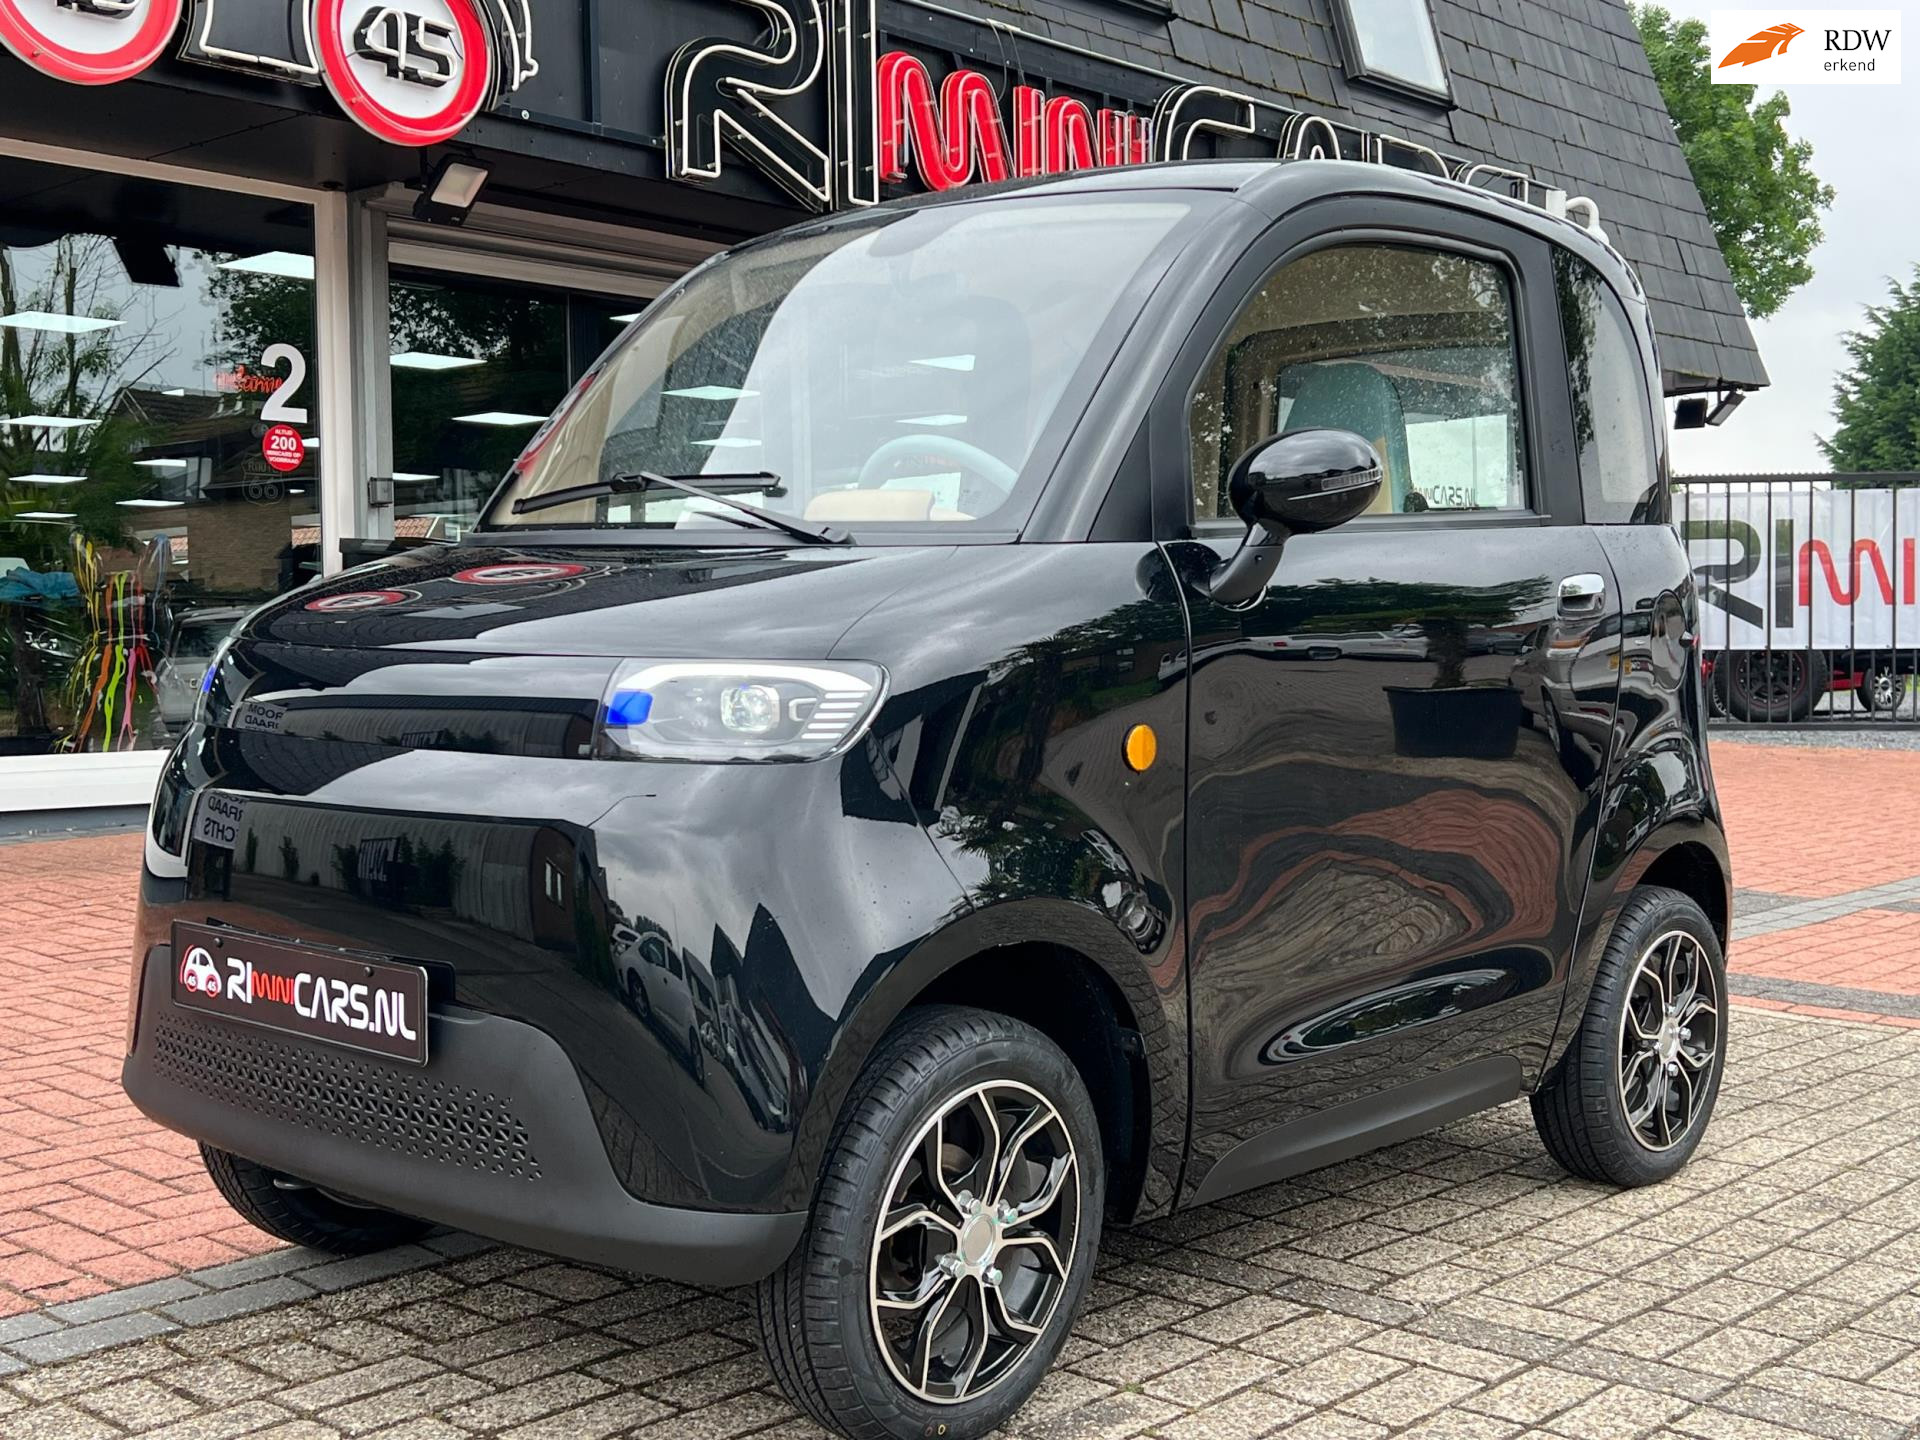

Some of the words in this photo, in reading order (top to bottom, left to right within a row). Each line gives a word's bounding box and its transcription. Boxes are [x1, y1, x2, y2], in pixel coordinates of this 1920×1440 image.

[353, 4, 458, 88] 45
[261, 343, 307, 423] 2
[270, 435, 297, 451] 200
